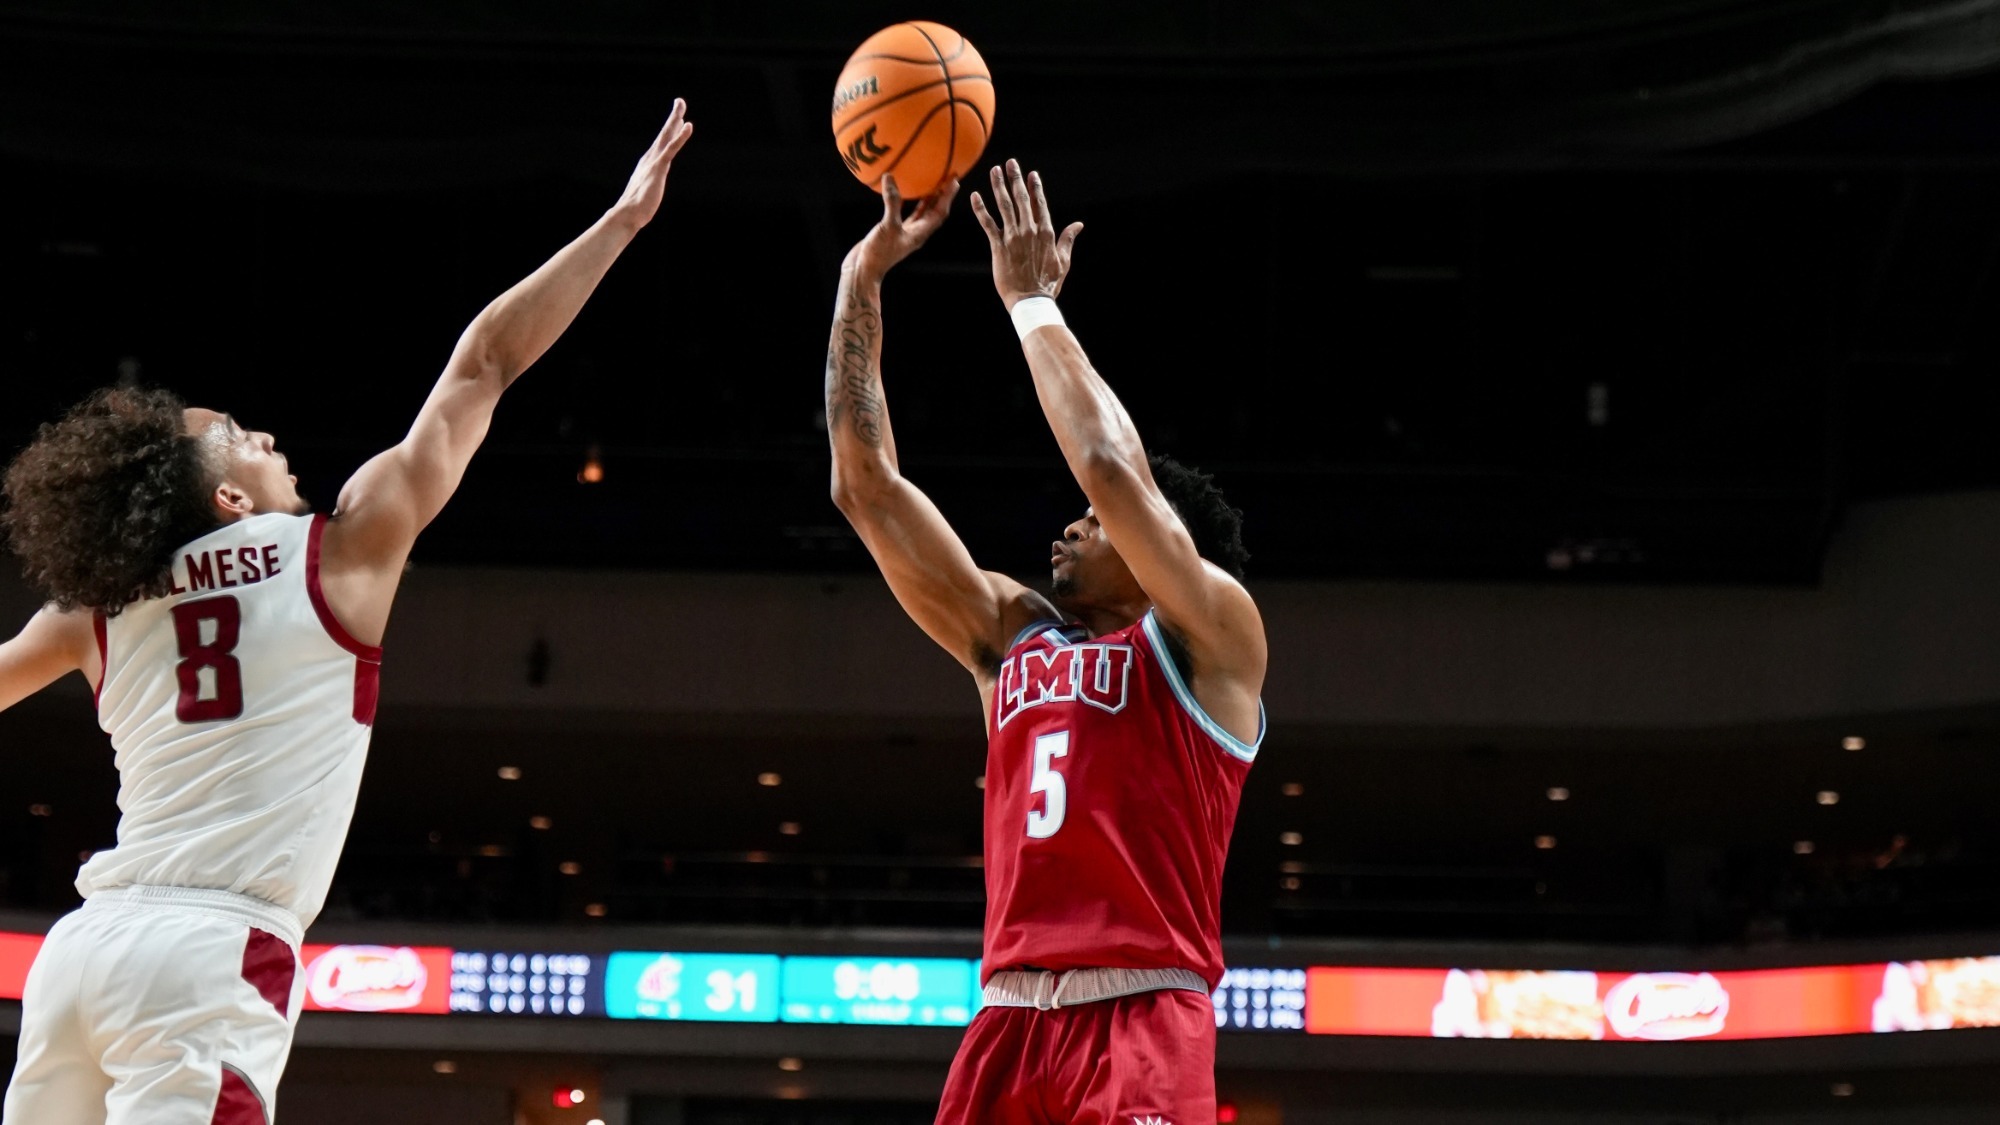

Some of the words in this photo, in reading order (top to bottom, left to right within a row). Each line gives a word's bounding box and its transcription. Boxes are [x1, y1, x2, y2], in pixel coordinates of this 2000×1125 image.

[124, 543, 281, 603] LMESE
[170, 595, 244, 724] 8
[998, 643, 1133, 733] LMU
[1027, 730, 1069, 839] 5
[704, 969, 757, 1013] 31
